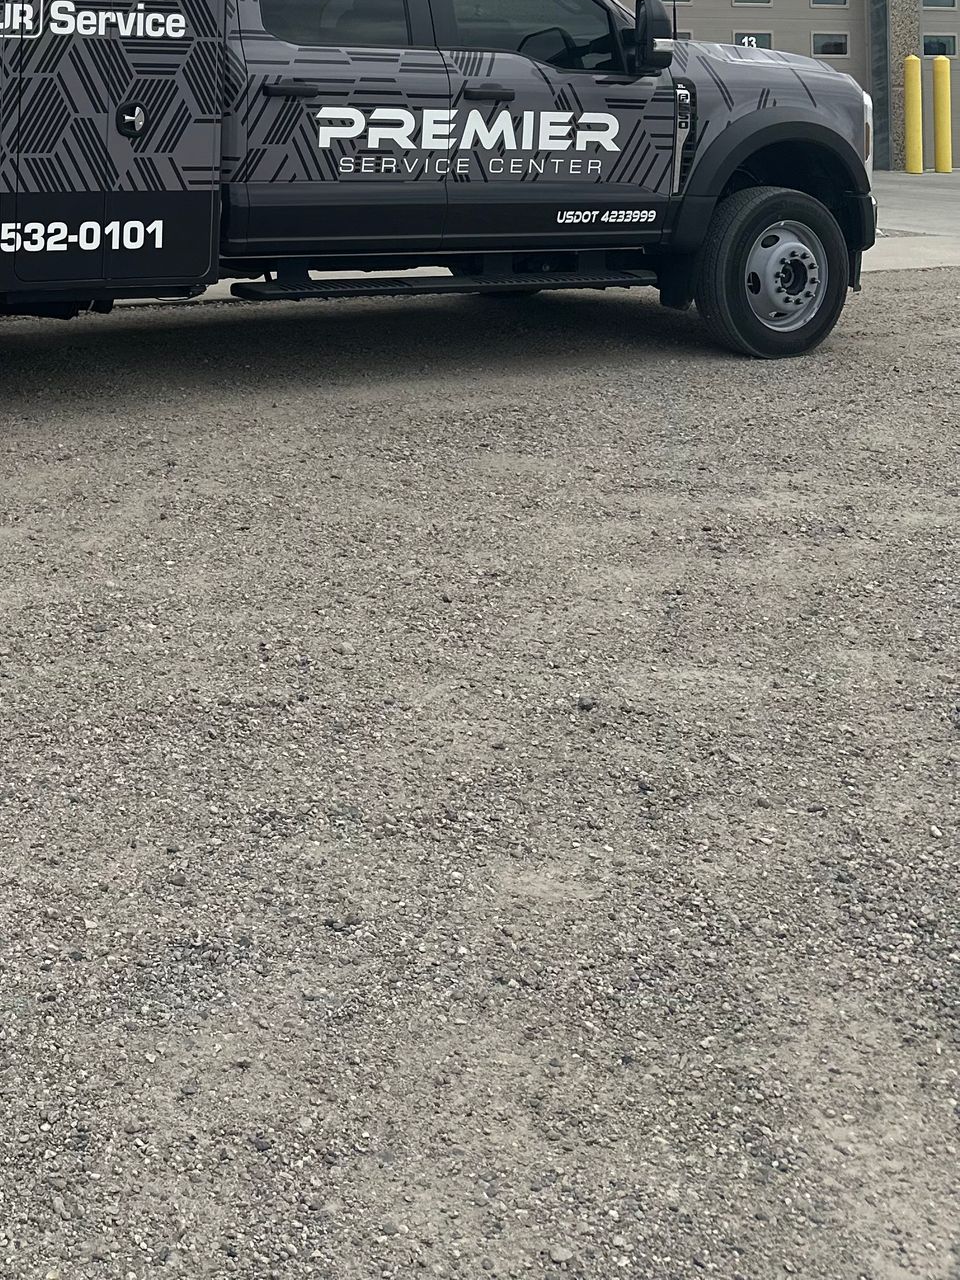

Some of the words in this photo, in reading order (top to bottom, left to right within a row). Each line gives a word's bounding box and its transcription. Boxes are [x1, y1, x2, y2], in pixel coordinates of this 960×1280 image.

[49, 0, 187, 38] Service
[741, 36, 757, 48] 13
[315, 107, 622, 153] PREMIER
[339, 157, 471, 175] SERVICE
[488, 158, 603, 175] CENTER
[556, 210, 600, 224] USDOT
[600, 210, 657, 223] 4233999
